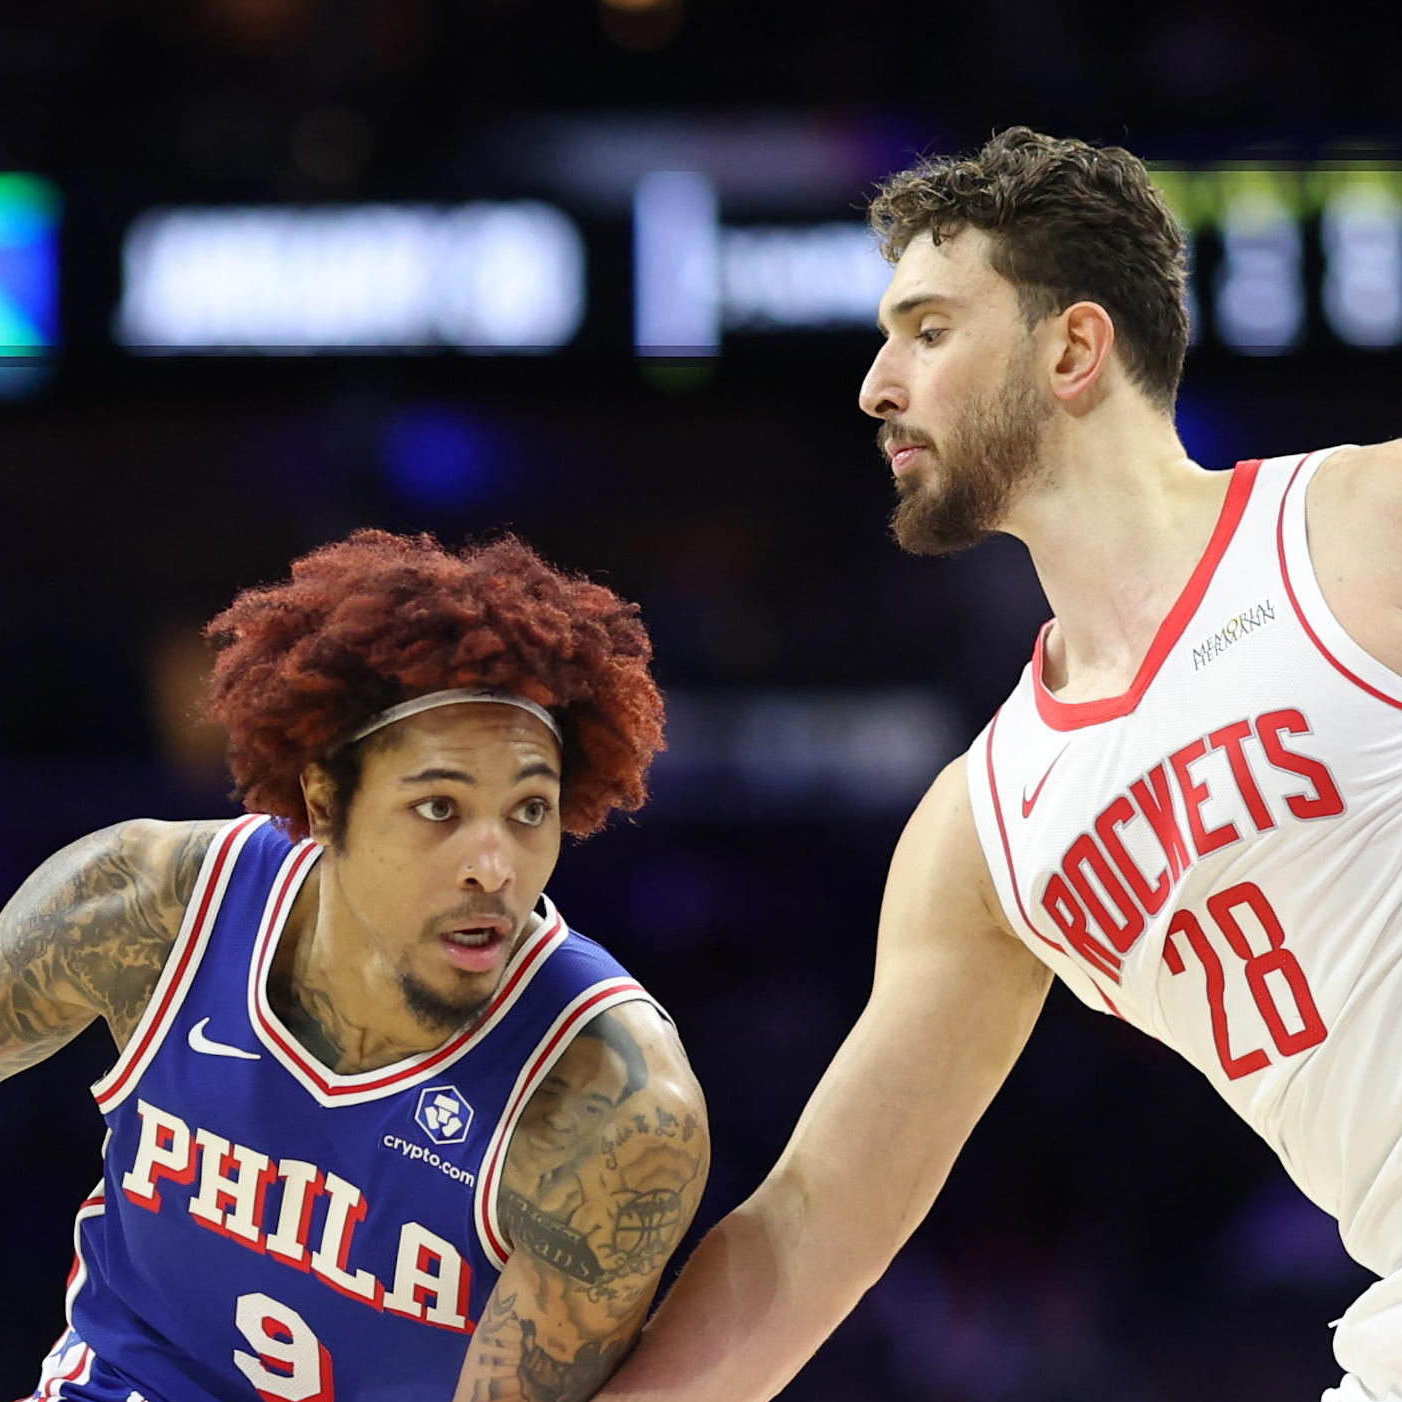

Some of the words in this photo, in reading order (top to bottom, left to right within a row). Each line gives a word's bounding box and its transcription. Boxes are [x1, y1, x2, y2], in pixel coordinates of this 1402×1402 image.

[1192, 599, 1275, 660] MEMORIAL
[1194, 607, 1276, 671] HERMANN
[1042, 708, 1347, 987] ROCKETS
[1162, 881, 1328, 1081] 28
[122, 1099, 477, 1335] PHILA
[383, 1135, 475, 1188] crypto.com
